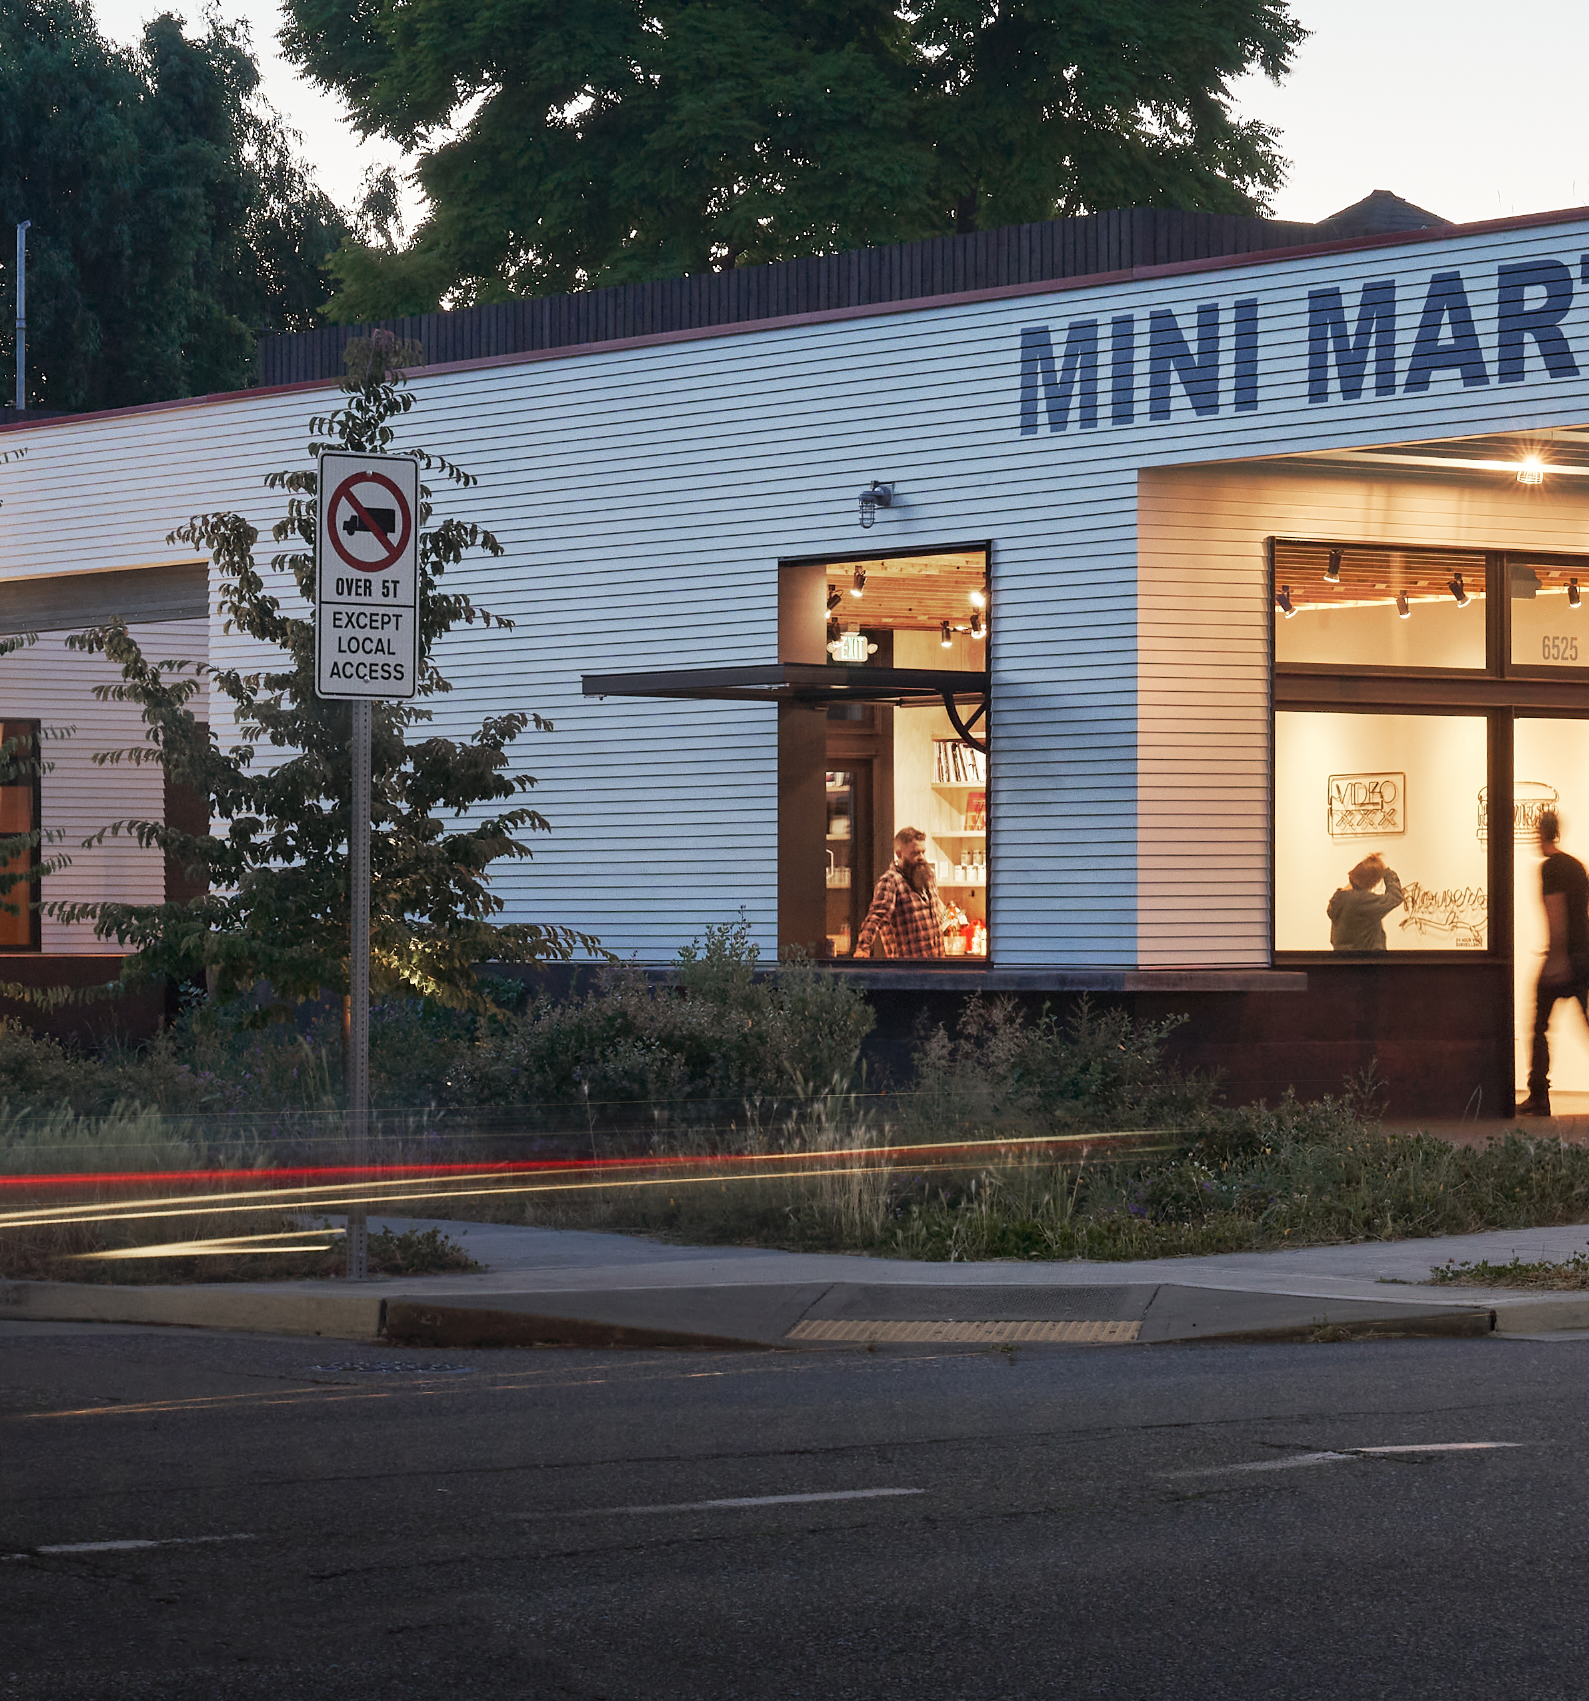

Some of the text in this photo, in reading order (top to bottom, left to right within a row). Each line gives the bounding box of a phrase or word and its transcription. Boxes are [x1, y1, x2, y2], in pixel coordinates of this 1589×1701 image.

[1019, 296, 1259, 436] MINI
[335, 577, 400, 599] OVER 5T
[332, 611, 403, 631] EXCEPT
[338, 635, 396, 656] LOCAL
[841, 637, 864, 660] EXIT
[1542, 635, 1579, 661] 6525
[329, 661, 405, 681] ACCESS
[1335, 780, 1397, 805] VIDEO
